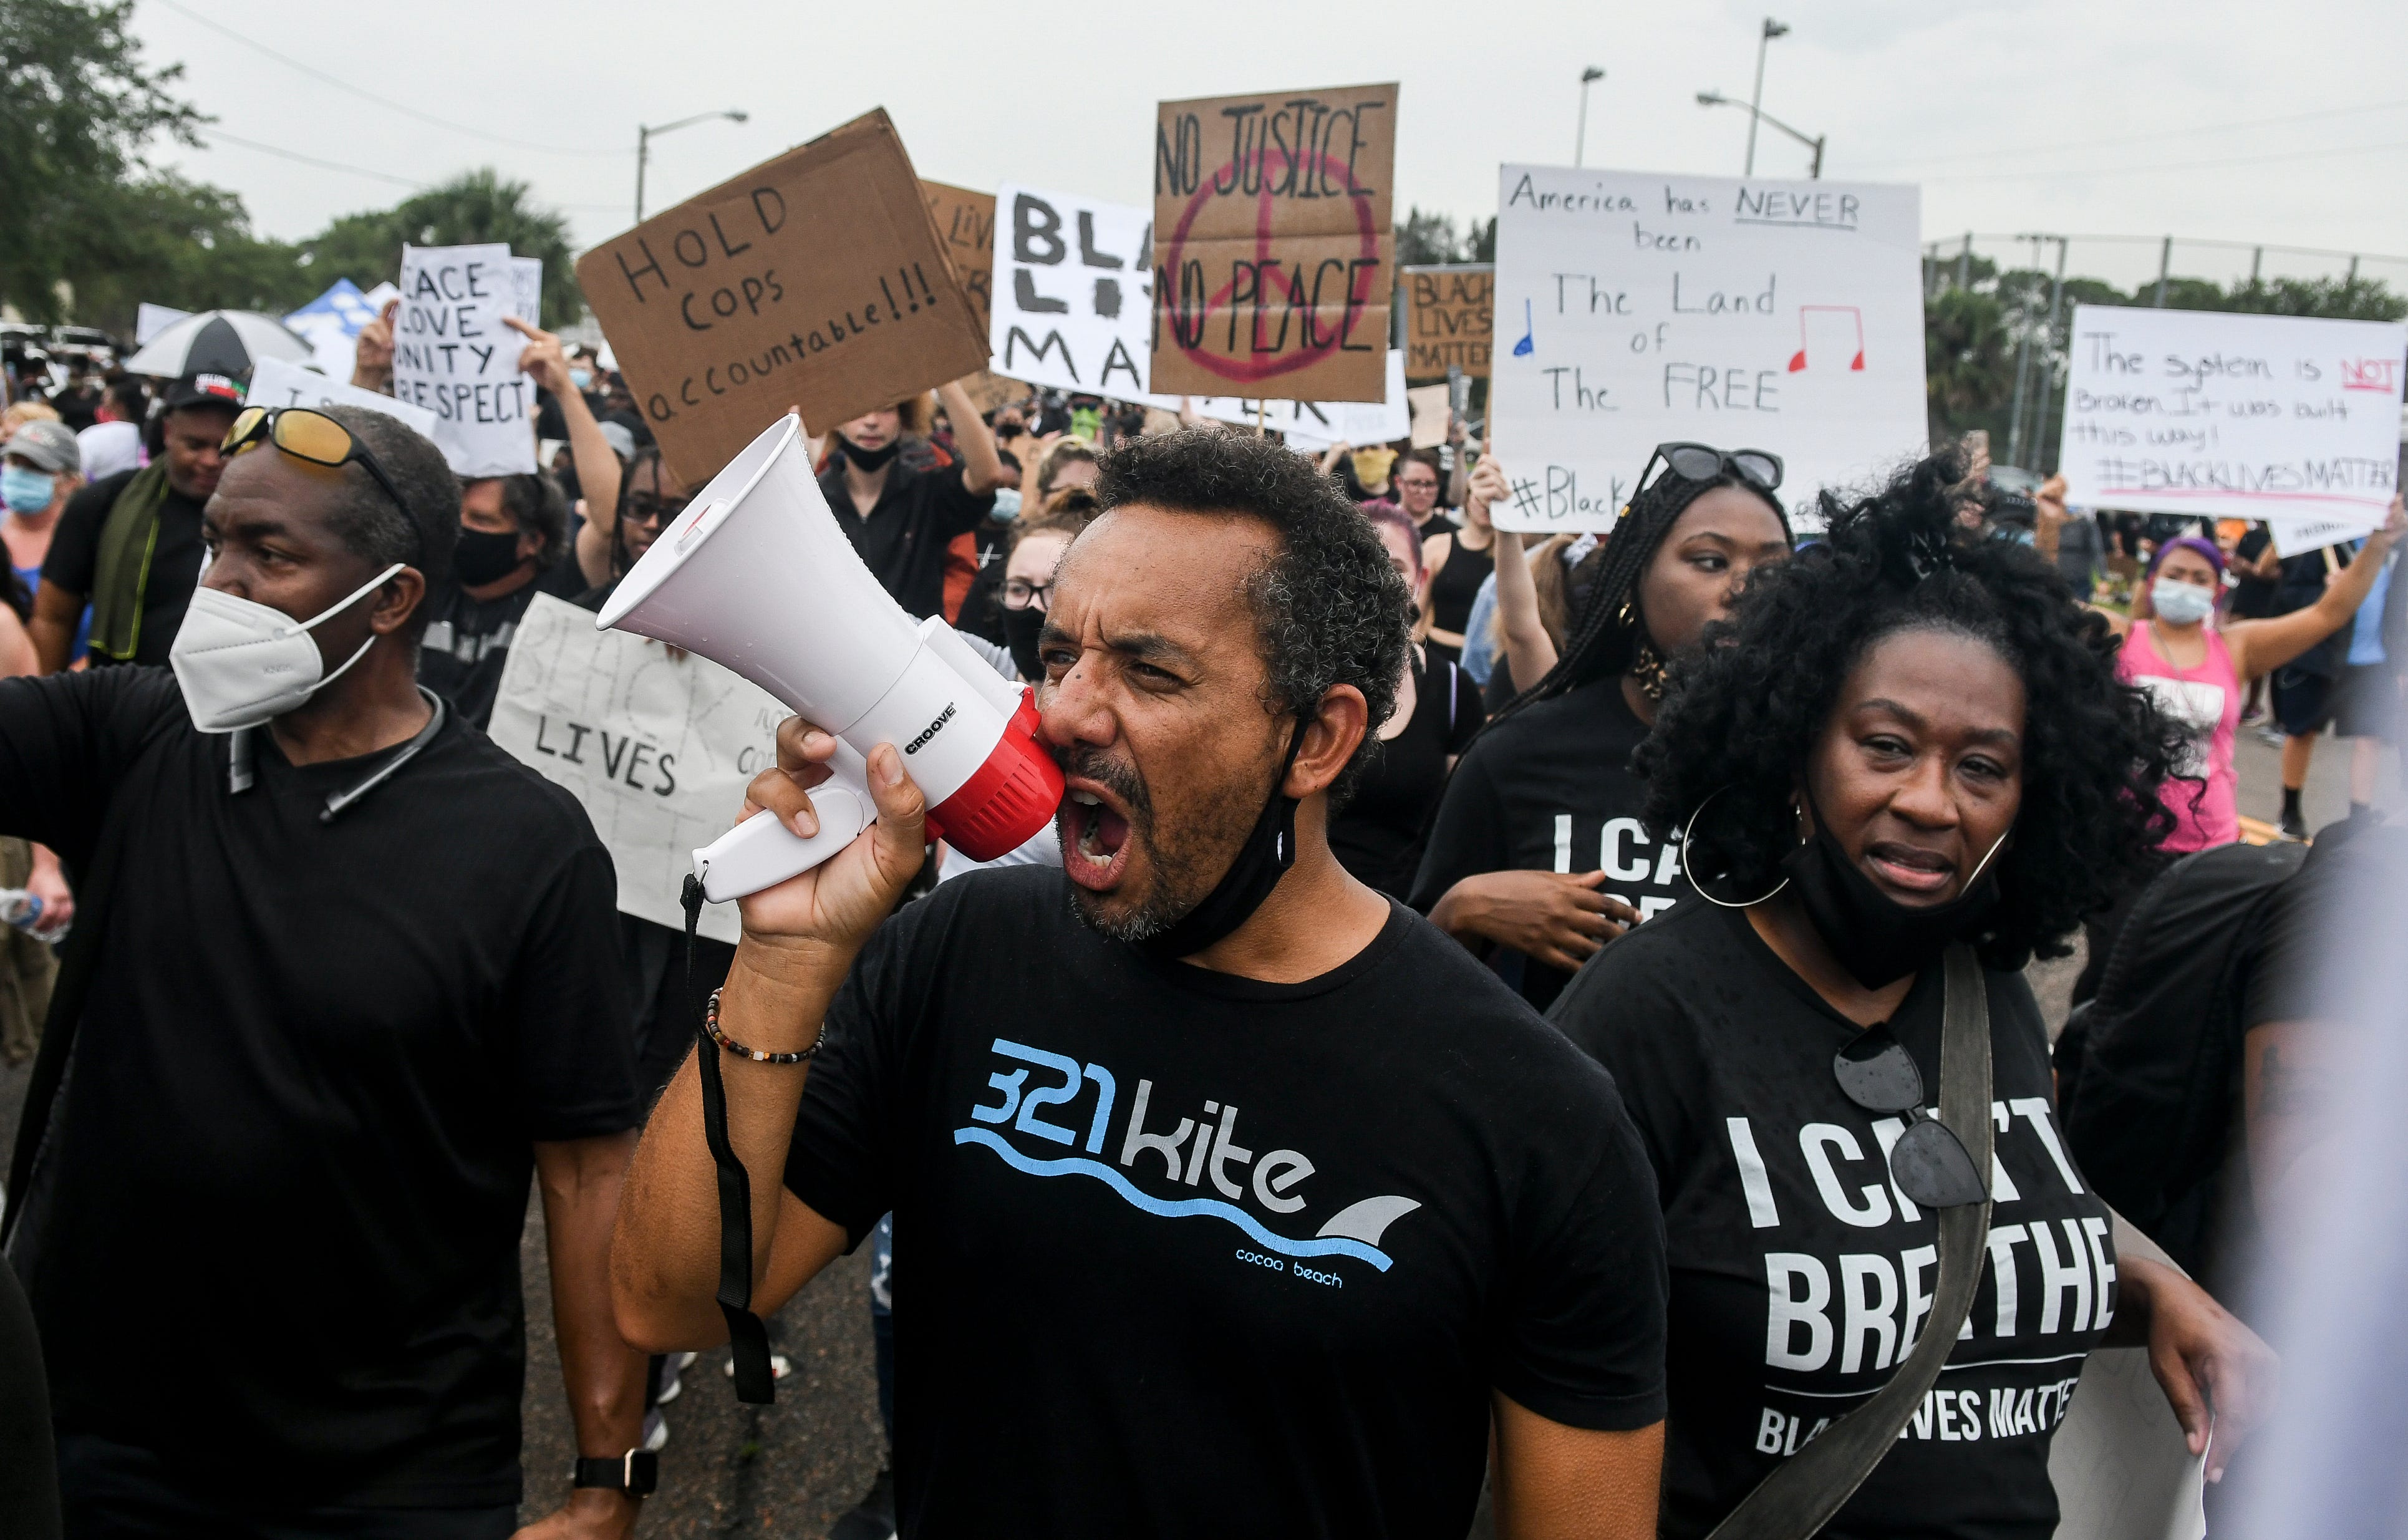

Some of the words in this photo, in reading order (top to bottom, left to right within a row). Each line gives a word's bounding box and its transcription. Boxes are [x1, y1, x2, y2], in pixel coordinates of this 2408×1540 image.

[1156, 112, 1200, 196] NO
[1214, 98, 1385, 199] JUSTICE
[1509, 173, 1637, 211] America
[1665, 185, 1710, 215] has
[1735, 186, 1860, 225] NEVER
[616, 188, 787, 303] HOLD
[1634, 220, 1701, 251] been
[1153, 258, 1205, 352] NO
[1228, 258, 1380, 352] PEACE
[1551, 272, 1632, 315] The
[1673, 271, 1776, 314] Land
[1630, 322, 1670, 354] of
[2082, 331, 2143, 373] The
[2295, 357, 2323, 382] is
[2340, 356, 2400, 384] NOT
[1542, 367, 1619, 412] The
[1664, 361, 1780, 413] FREE
[534, 715, 677, 797] LIVES
[905, 704, 956, 755] CROOVE
[1554, 814, 1572, 874] I
[971, 1038, 1116, 1154] 321
[1121, 1079, 1316, 1214] kite
[1726, 1117, 1780, 1229] I
[1235, 1248, 1284, 1272] cocoa
[1293, 1261, 1343, 1289] beach
[1764, 1217, 2117, 1374] BRETHE
[1989, 1377, 2079, 1438] MATTE
